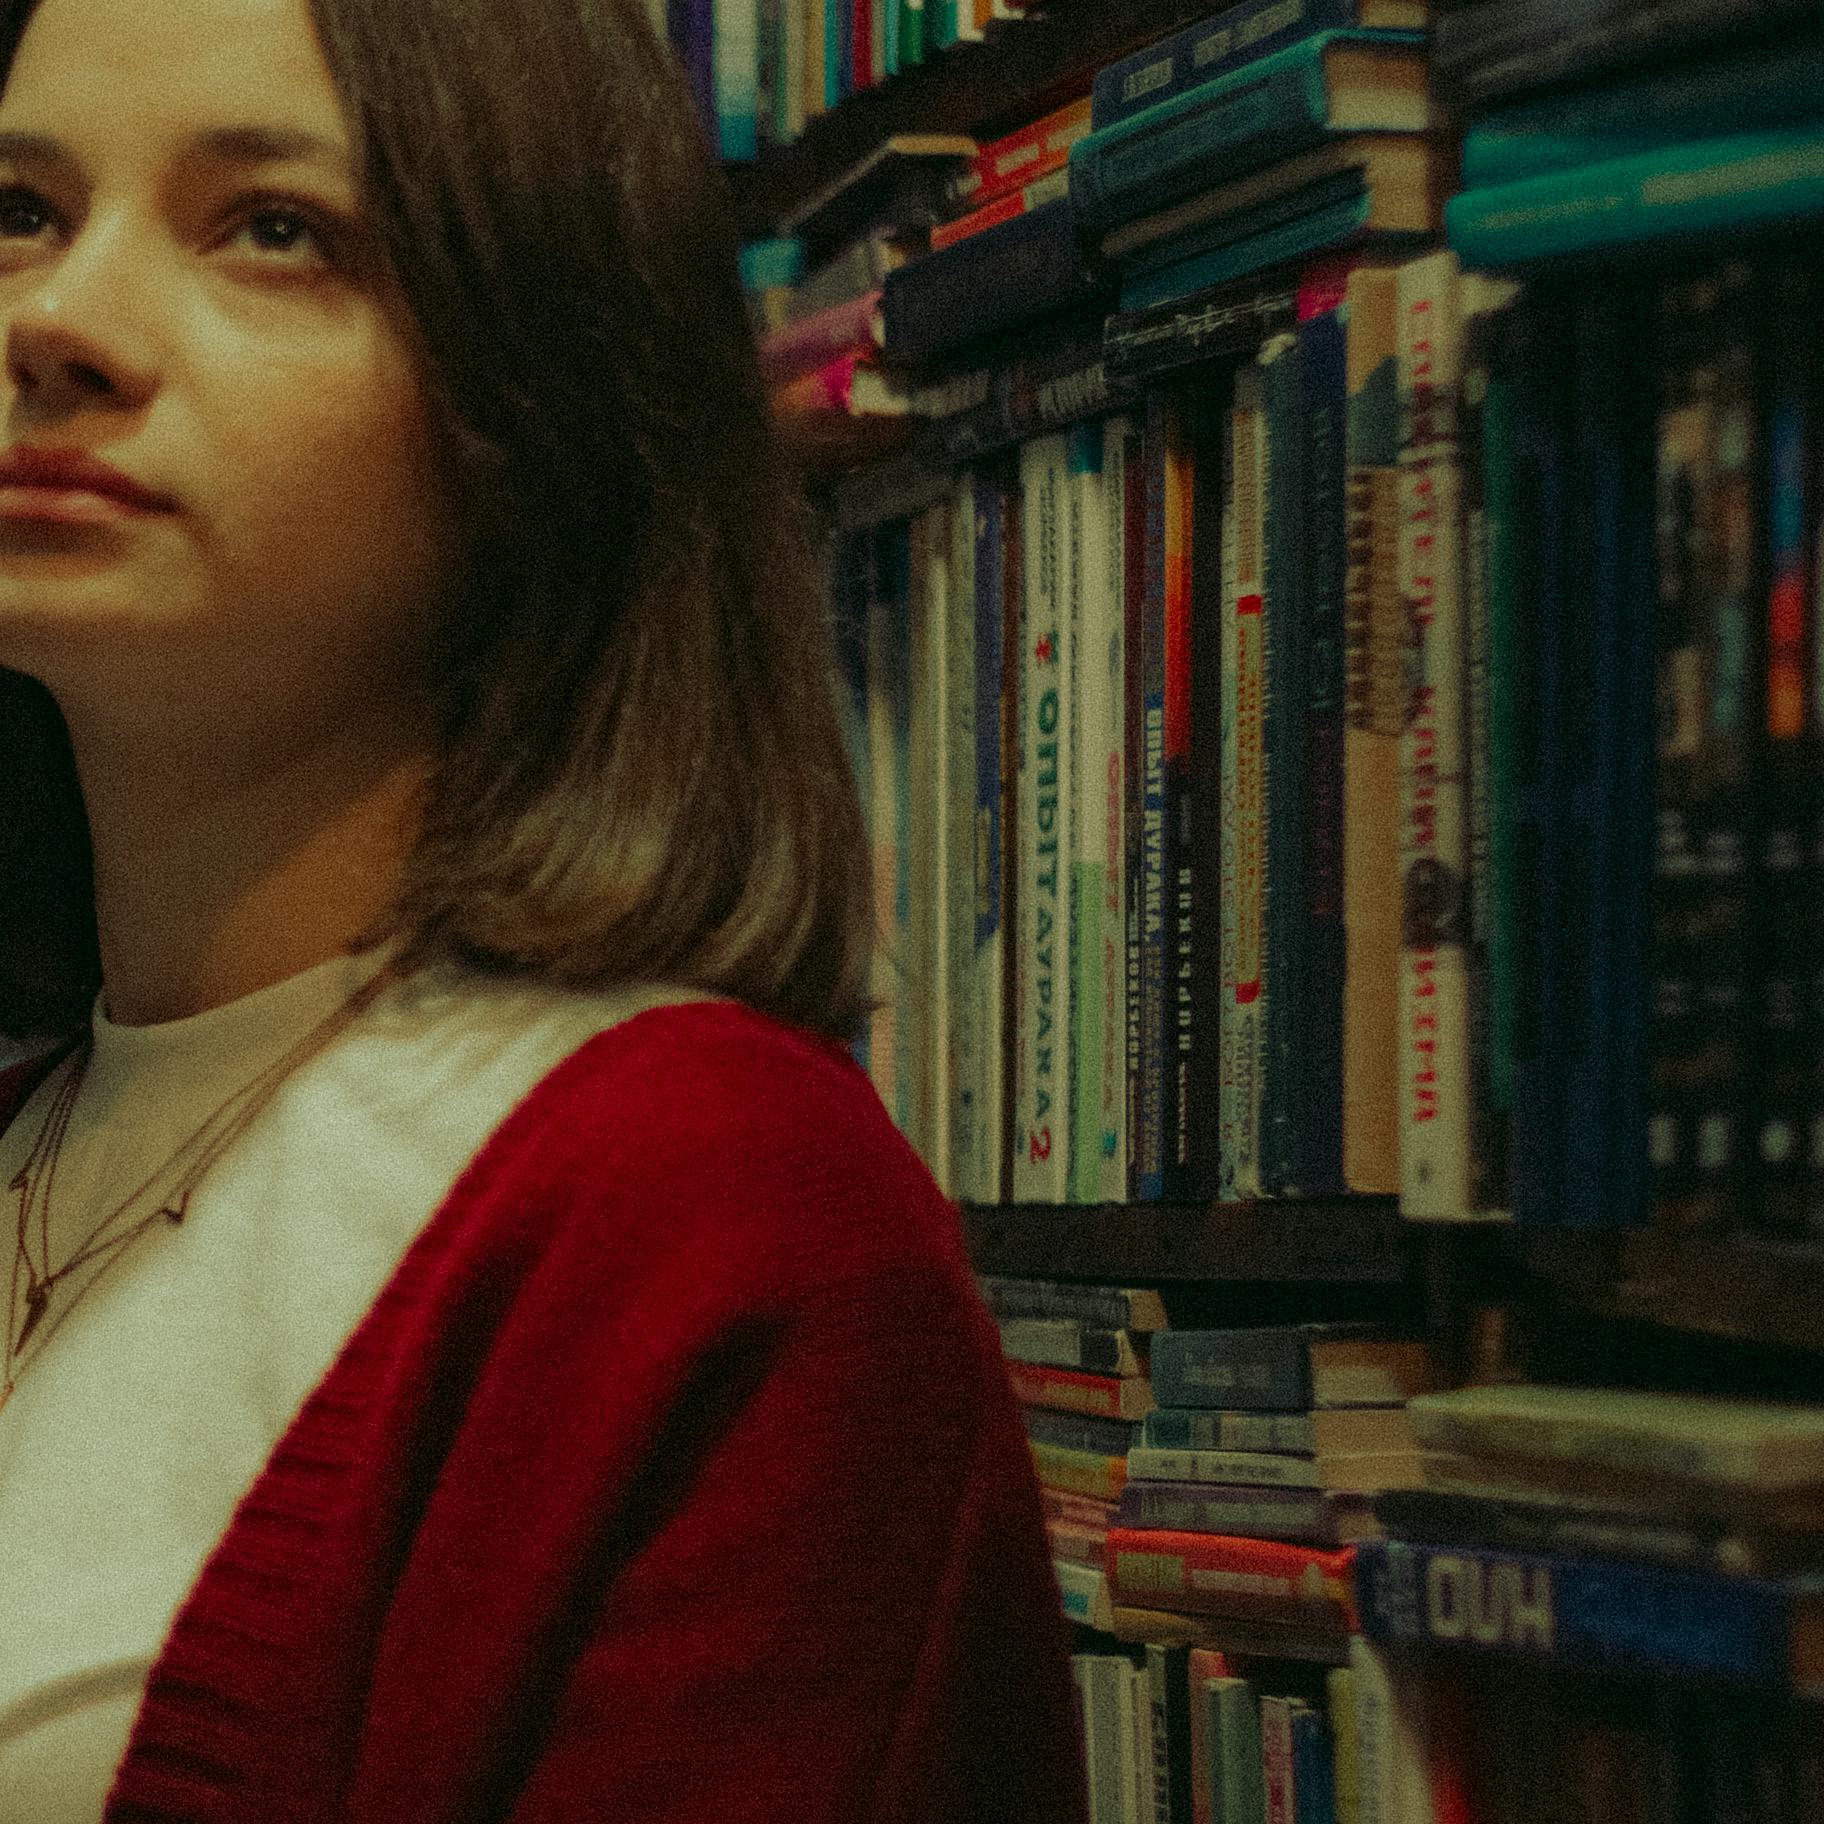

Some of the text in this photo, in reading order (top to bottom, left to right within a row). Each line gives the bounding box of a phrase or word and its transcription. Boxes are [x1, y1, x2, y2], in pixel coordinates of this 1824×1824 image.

[1029, 688, 1060, 1167] ОПЫТ ДУРАКА 2
